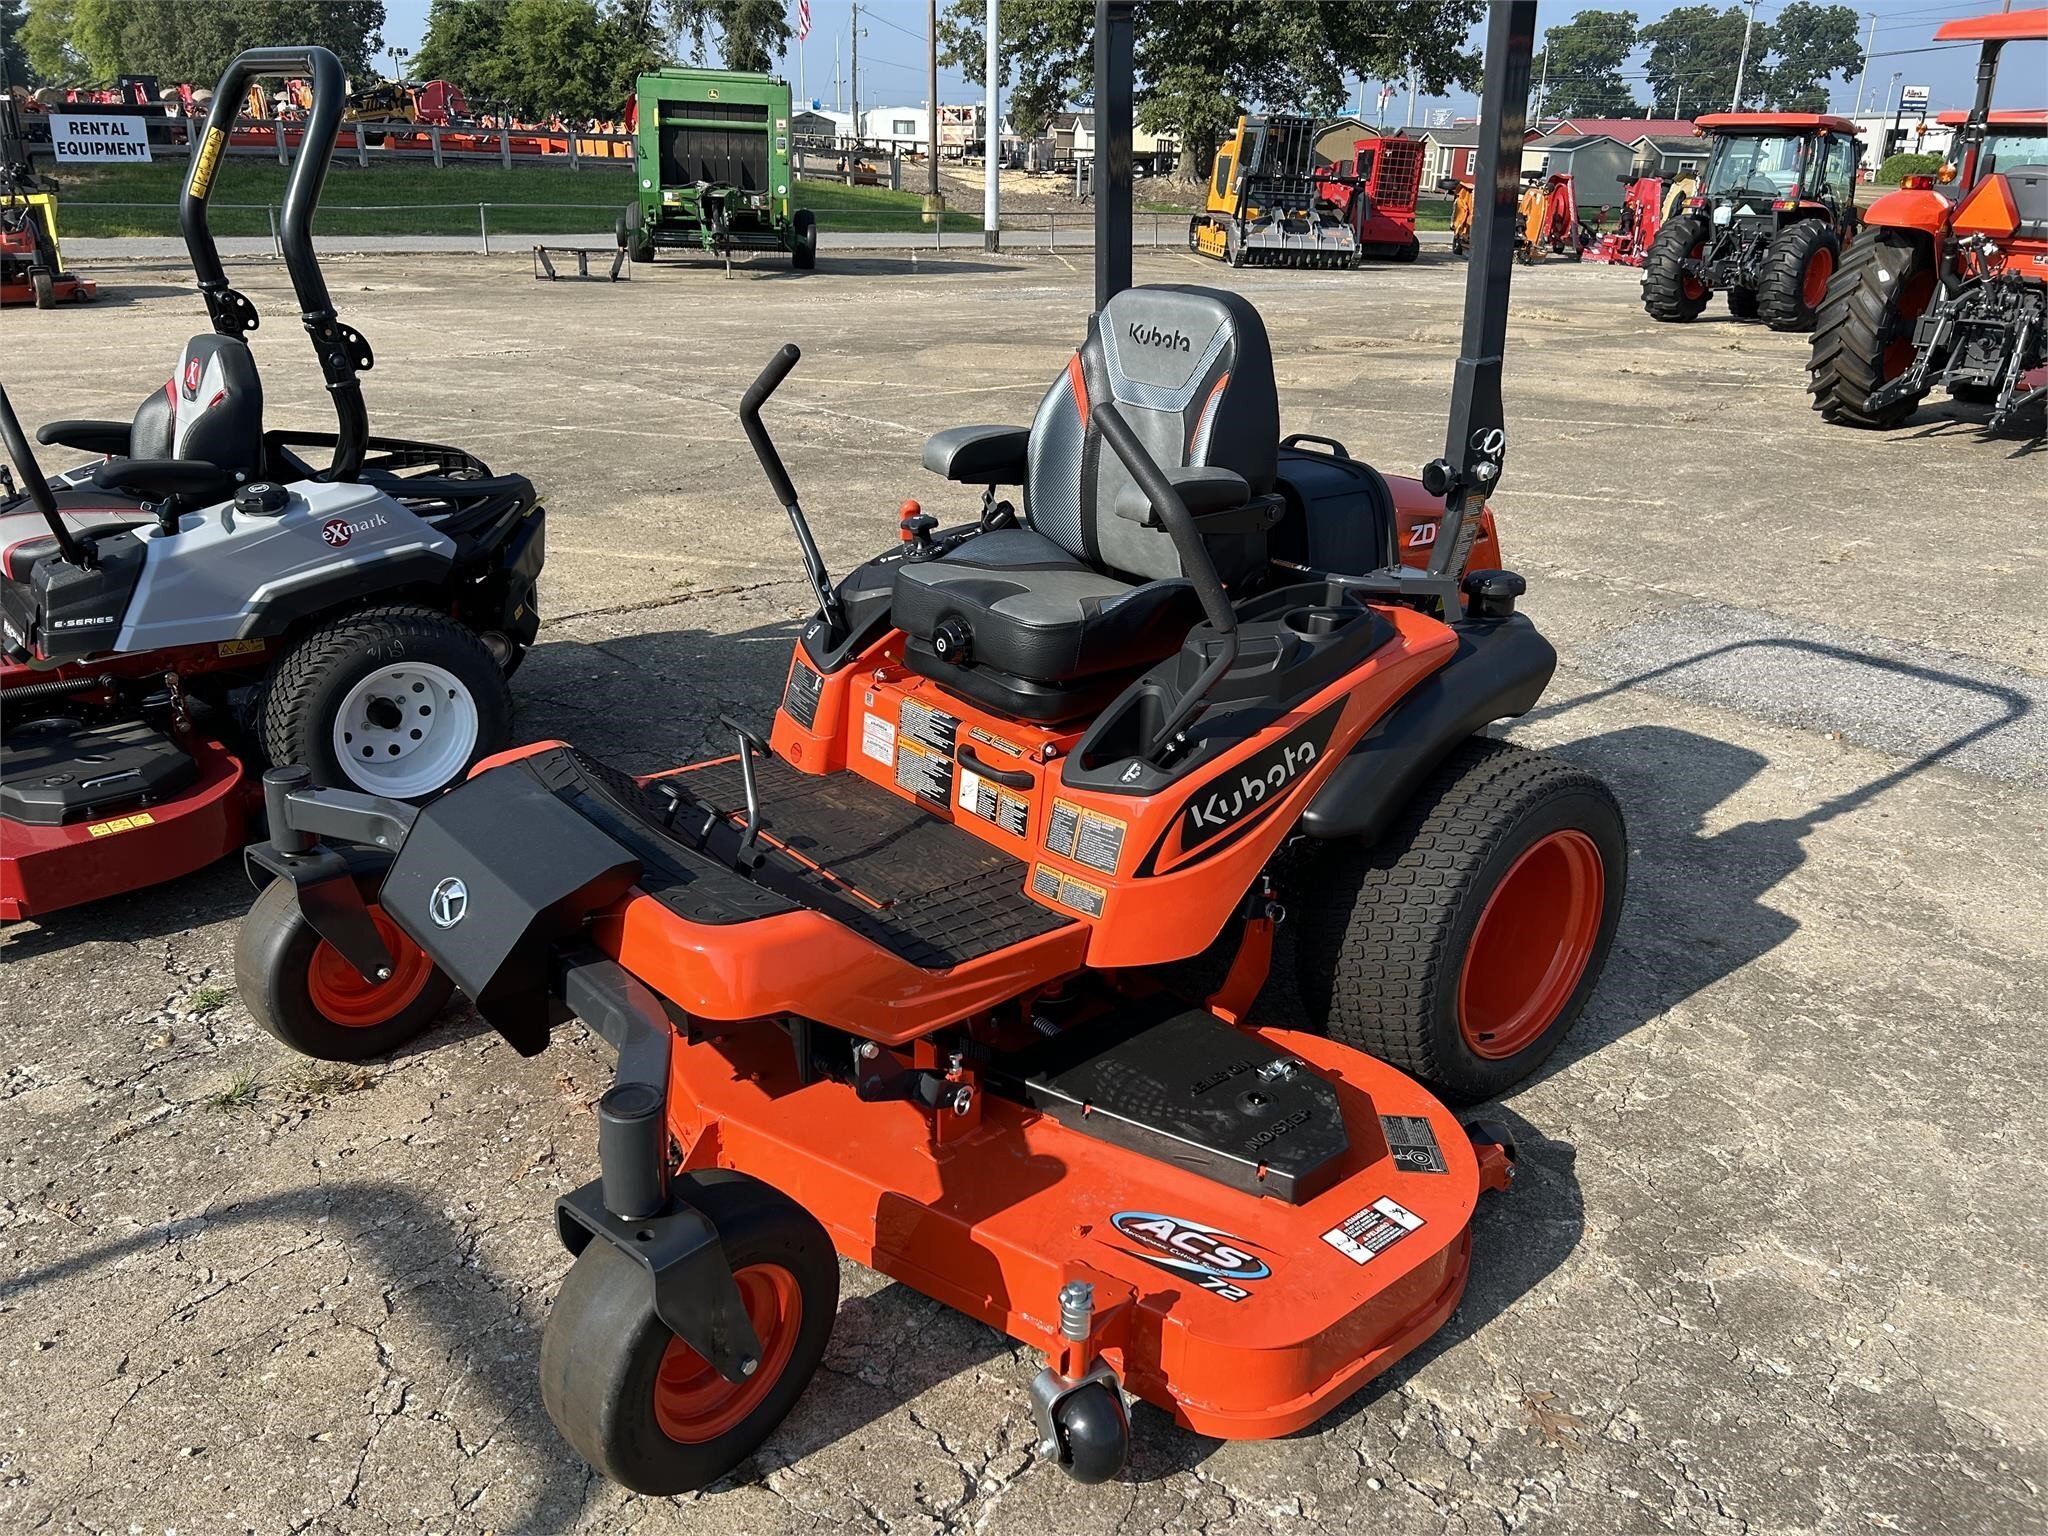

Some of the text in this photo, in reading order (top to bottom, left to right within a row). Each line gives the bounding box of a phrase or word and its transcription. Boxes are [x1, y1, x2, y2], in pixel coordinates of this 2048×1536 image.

[69, 122, 129, 136] RENTAL
[57, 142, 146, 156] EQUIPMENT
[1129, 322, 1190, 352] Kubota
[1190, 740, 1317, 829] Kubota
[1130, 1219, 1253, 1269] ACS
[1199, 1275, 1248, 1301] 72
